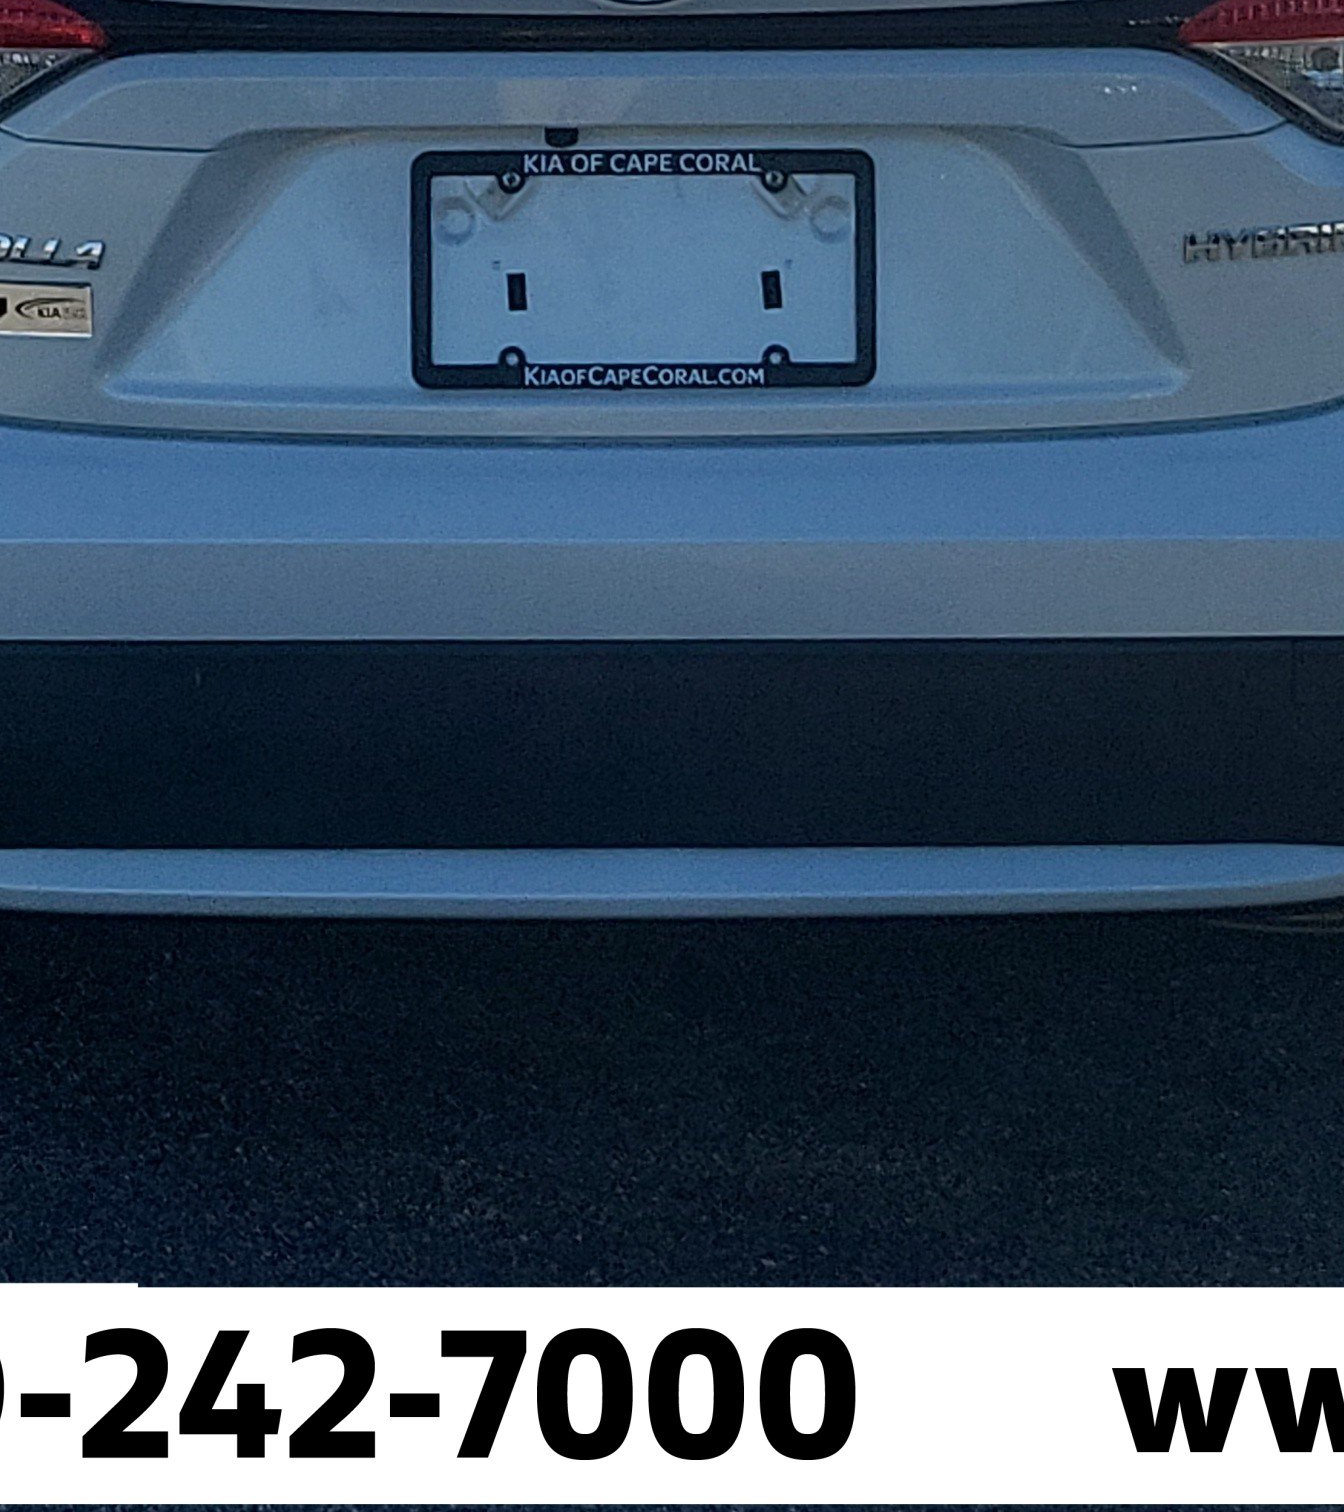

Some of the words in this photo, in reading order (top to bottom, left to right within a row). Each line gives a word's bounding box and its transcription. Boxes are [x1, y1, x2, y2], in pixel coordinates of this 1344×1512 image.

[524, 153, 564, 173] KIA
[570, 153, 604, 172] OF
[610, 152, 671, 173] CAPE
[679, 153, 762, 173] CORAL
